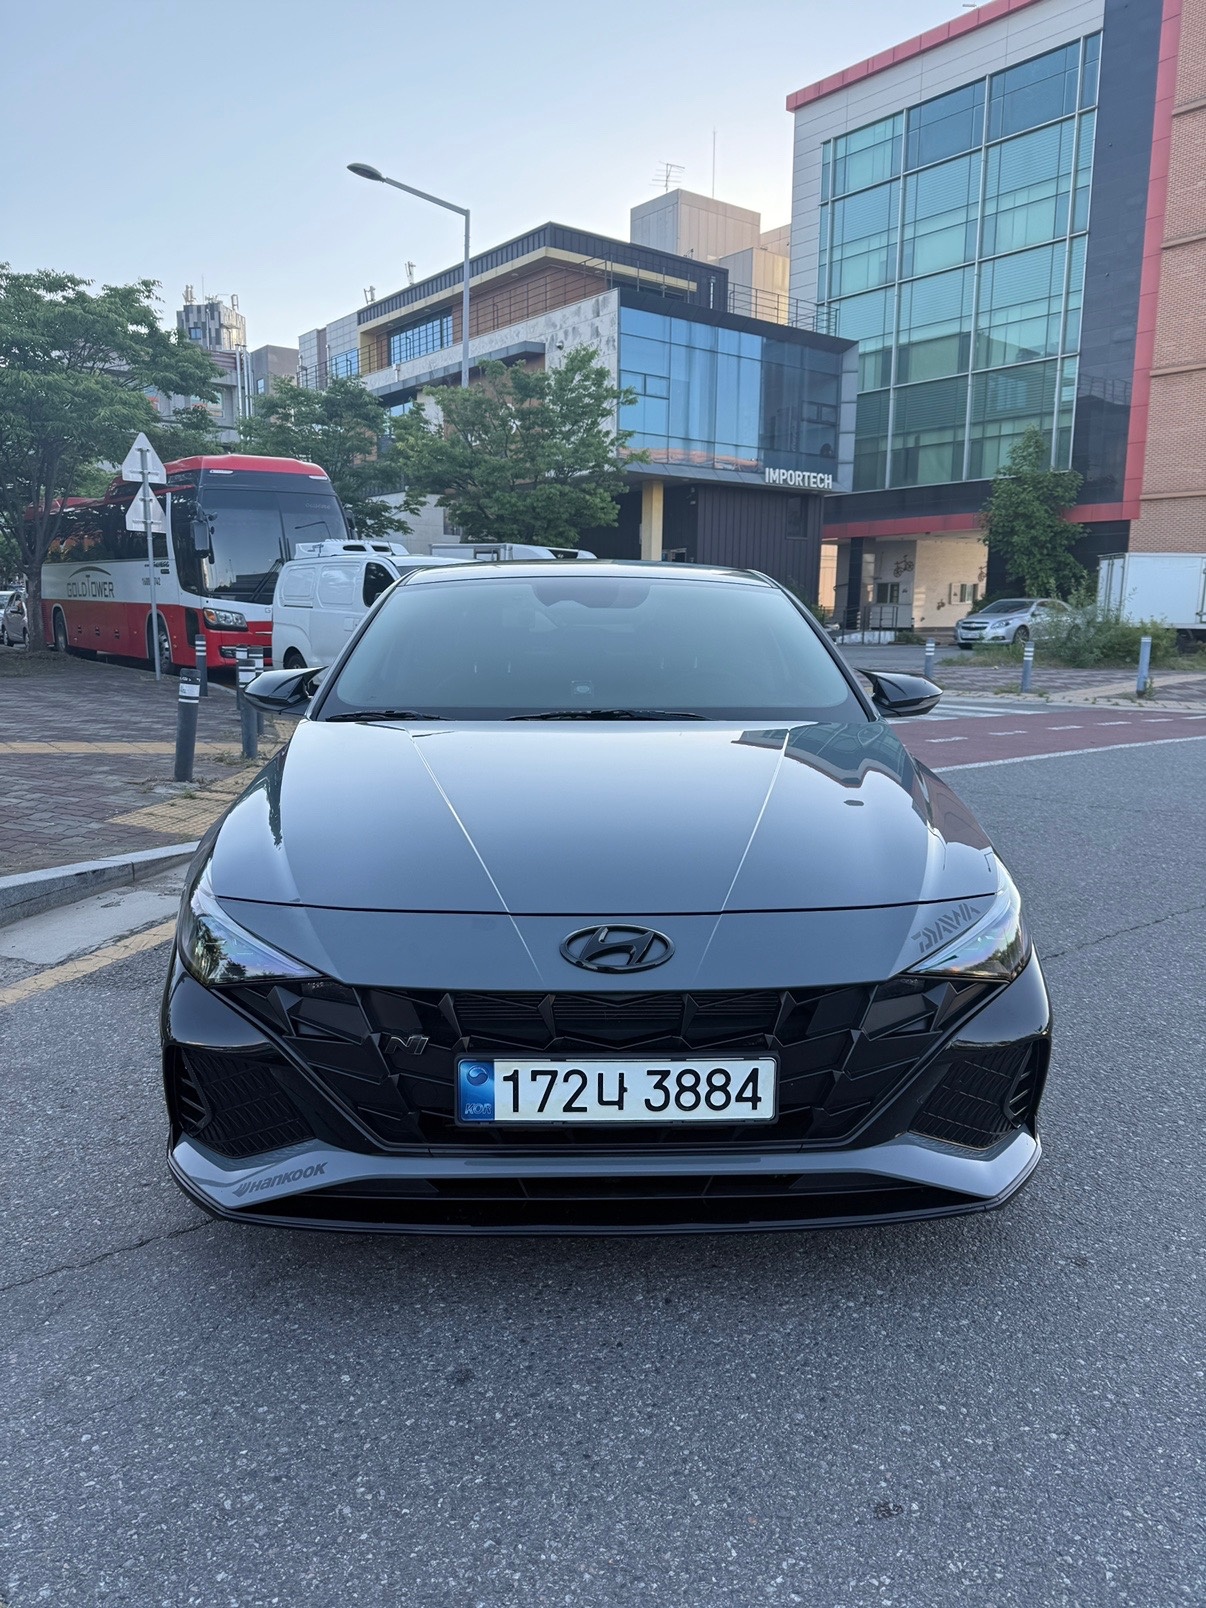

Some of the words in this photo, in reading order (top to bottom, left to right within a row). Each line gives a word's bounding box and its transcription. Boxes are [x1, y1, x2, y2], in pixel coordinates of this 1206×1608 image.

[765, 467, 833, 490] IMPORTECH
[502, 1068, 628, 1113] 172나
[644, 1067, 763, 1112] 3884
[464, 1102, 493, 1115] KOR
